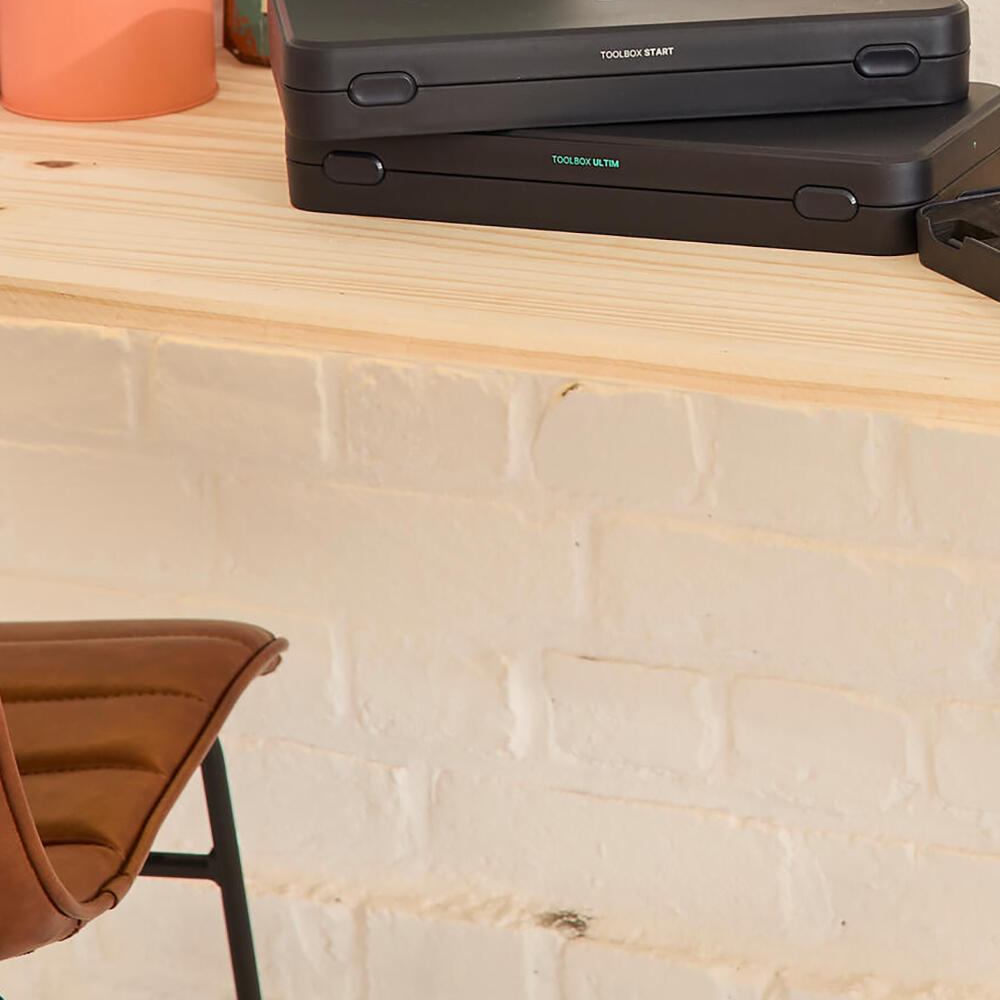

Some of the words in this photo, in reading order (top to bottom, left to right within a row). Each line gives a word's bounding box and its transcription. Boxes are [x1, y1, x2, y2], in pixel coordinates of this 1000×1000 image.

[600, 49, 643, 60] TOOLBOX
[644, 46, 675, 57] START
[552, 155, 592, 166] TOOLBOX
[592, 158, 620, 168] ULTIM
